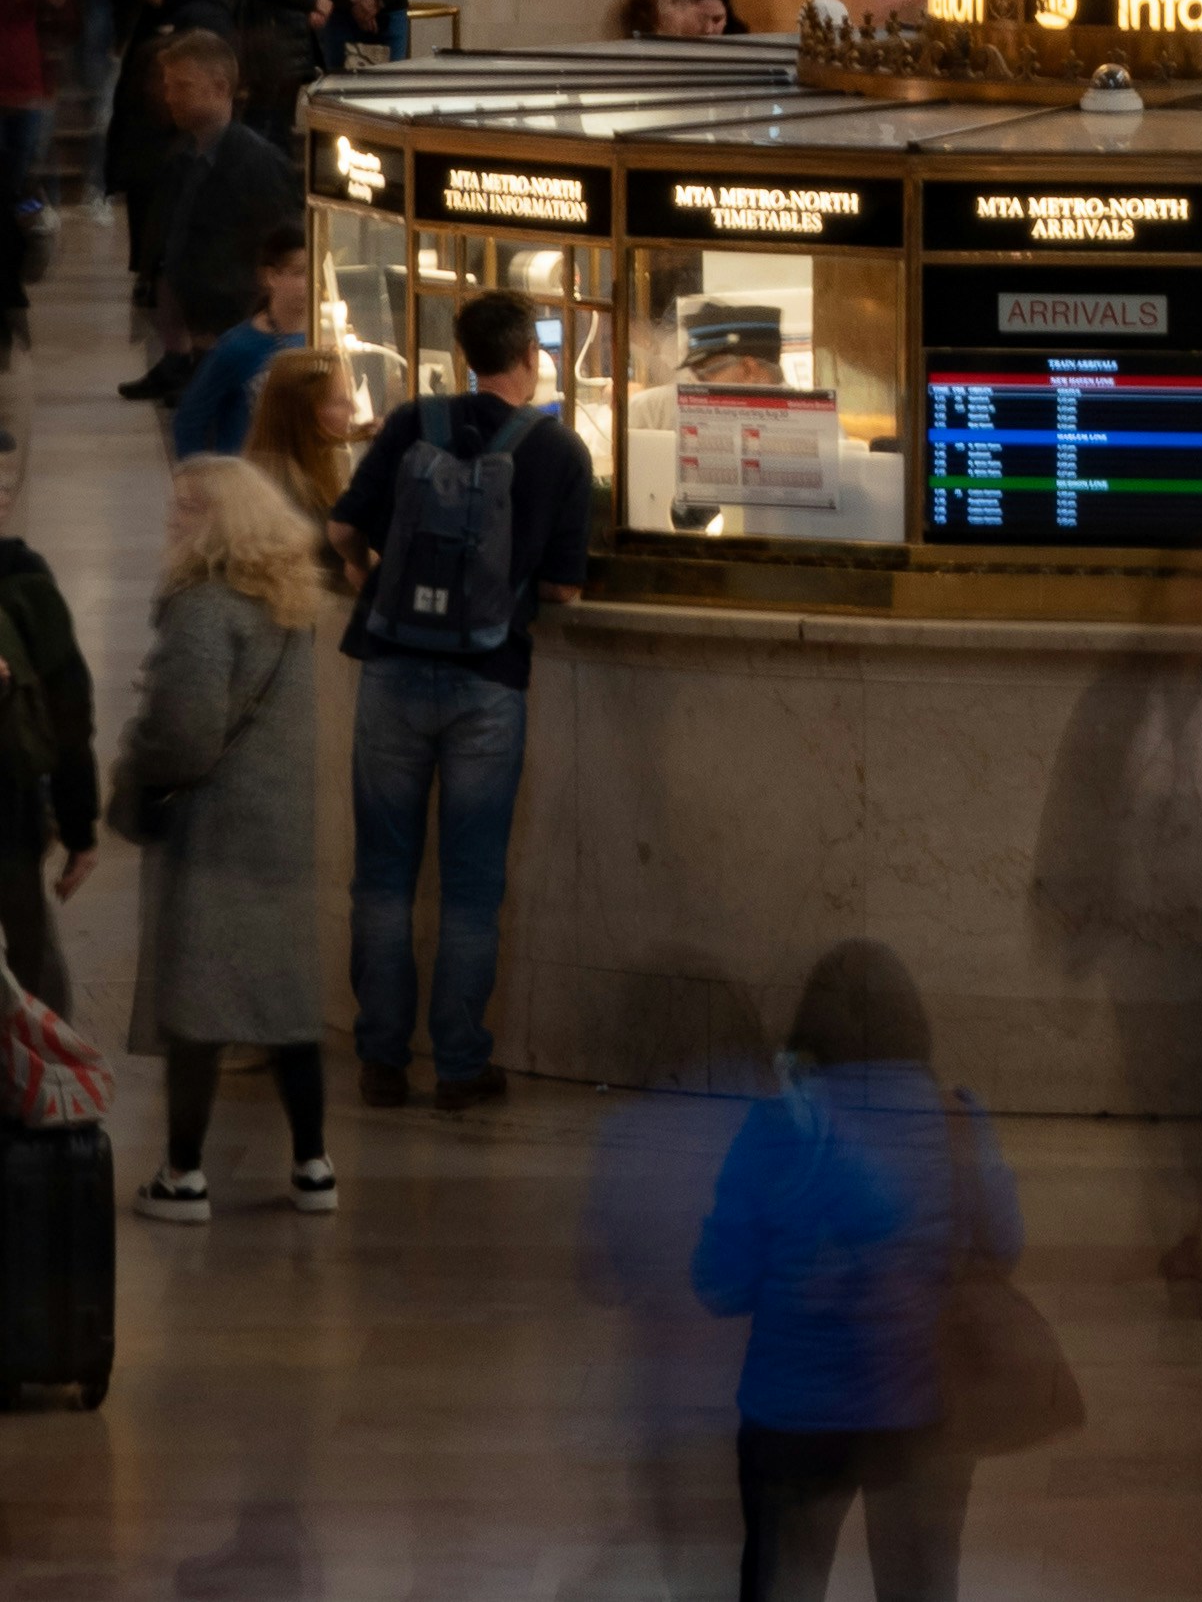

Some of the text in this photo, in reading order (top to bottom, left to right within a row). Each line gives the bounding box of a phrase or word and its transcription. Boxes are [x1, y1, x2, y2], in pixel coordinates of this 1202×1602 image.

[450, 169, 582, 201] MTA METRO-NORTH
[444, 189, 588, 223] TRAIN INFORMATION
[675, 185, 859, 214] MTA METRO-NORTH
[977, 197, 1189, 220] MTA METRO-NORTH
[711, 208, 823, 233] TIMETABLES
[1031, 218, 1135, 240] ARRIVALS
[1008, 299, 1158, 327] ARRIVALS
